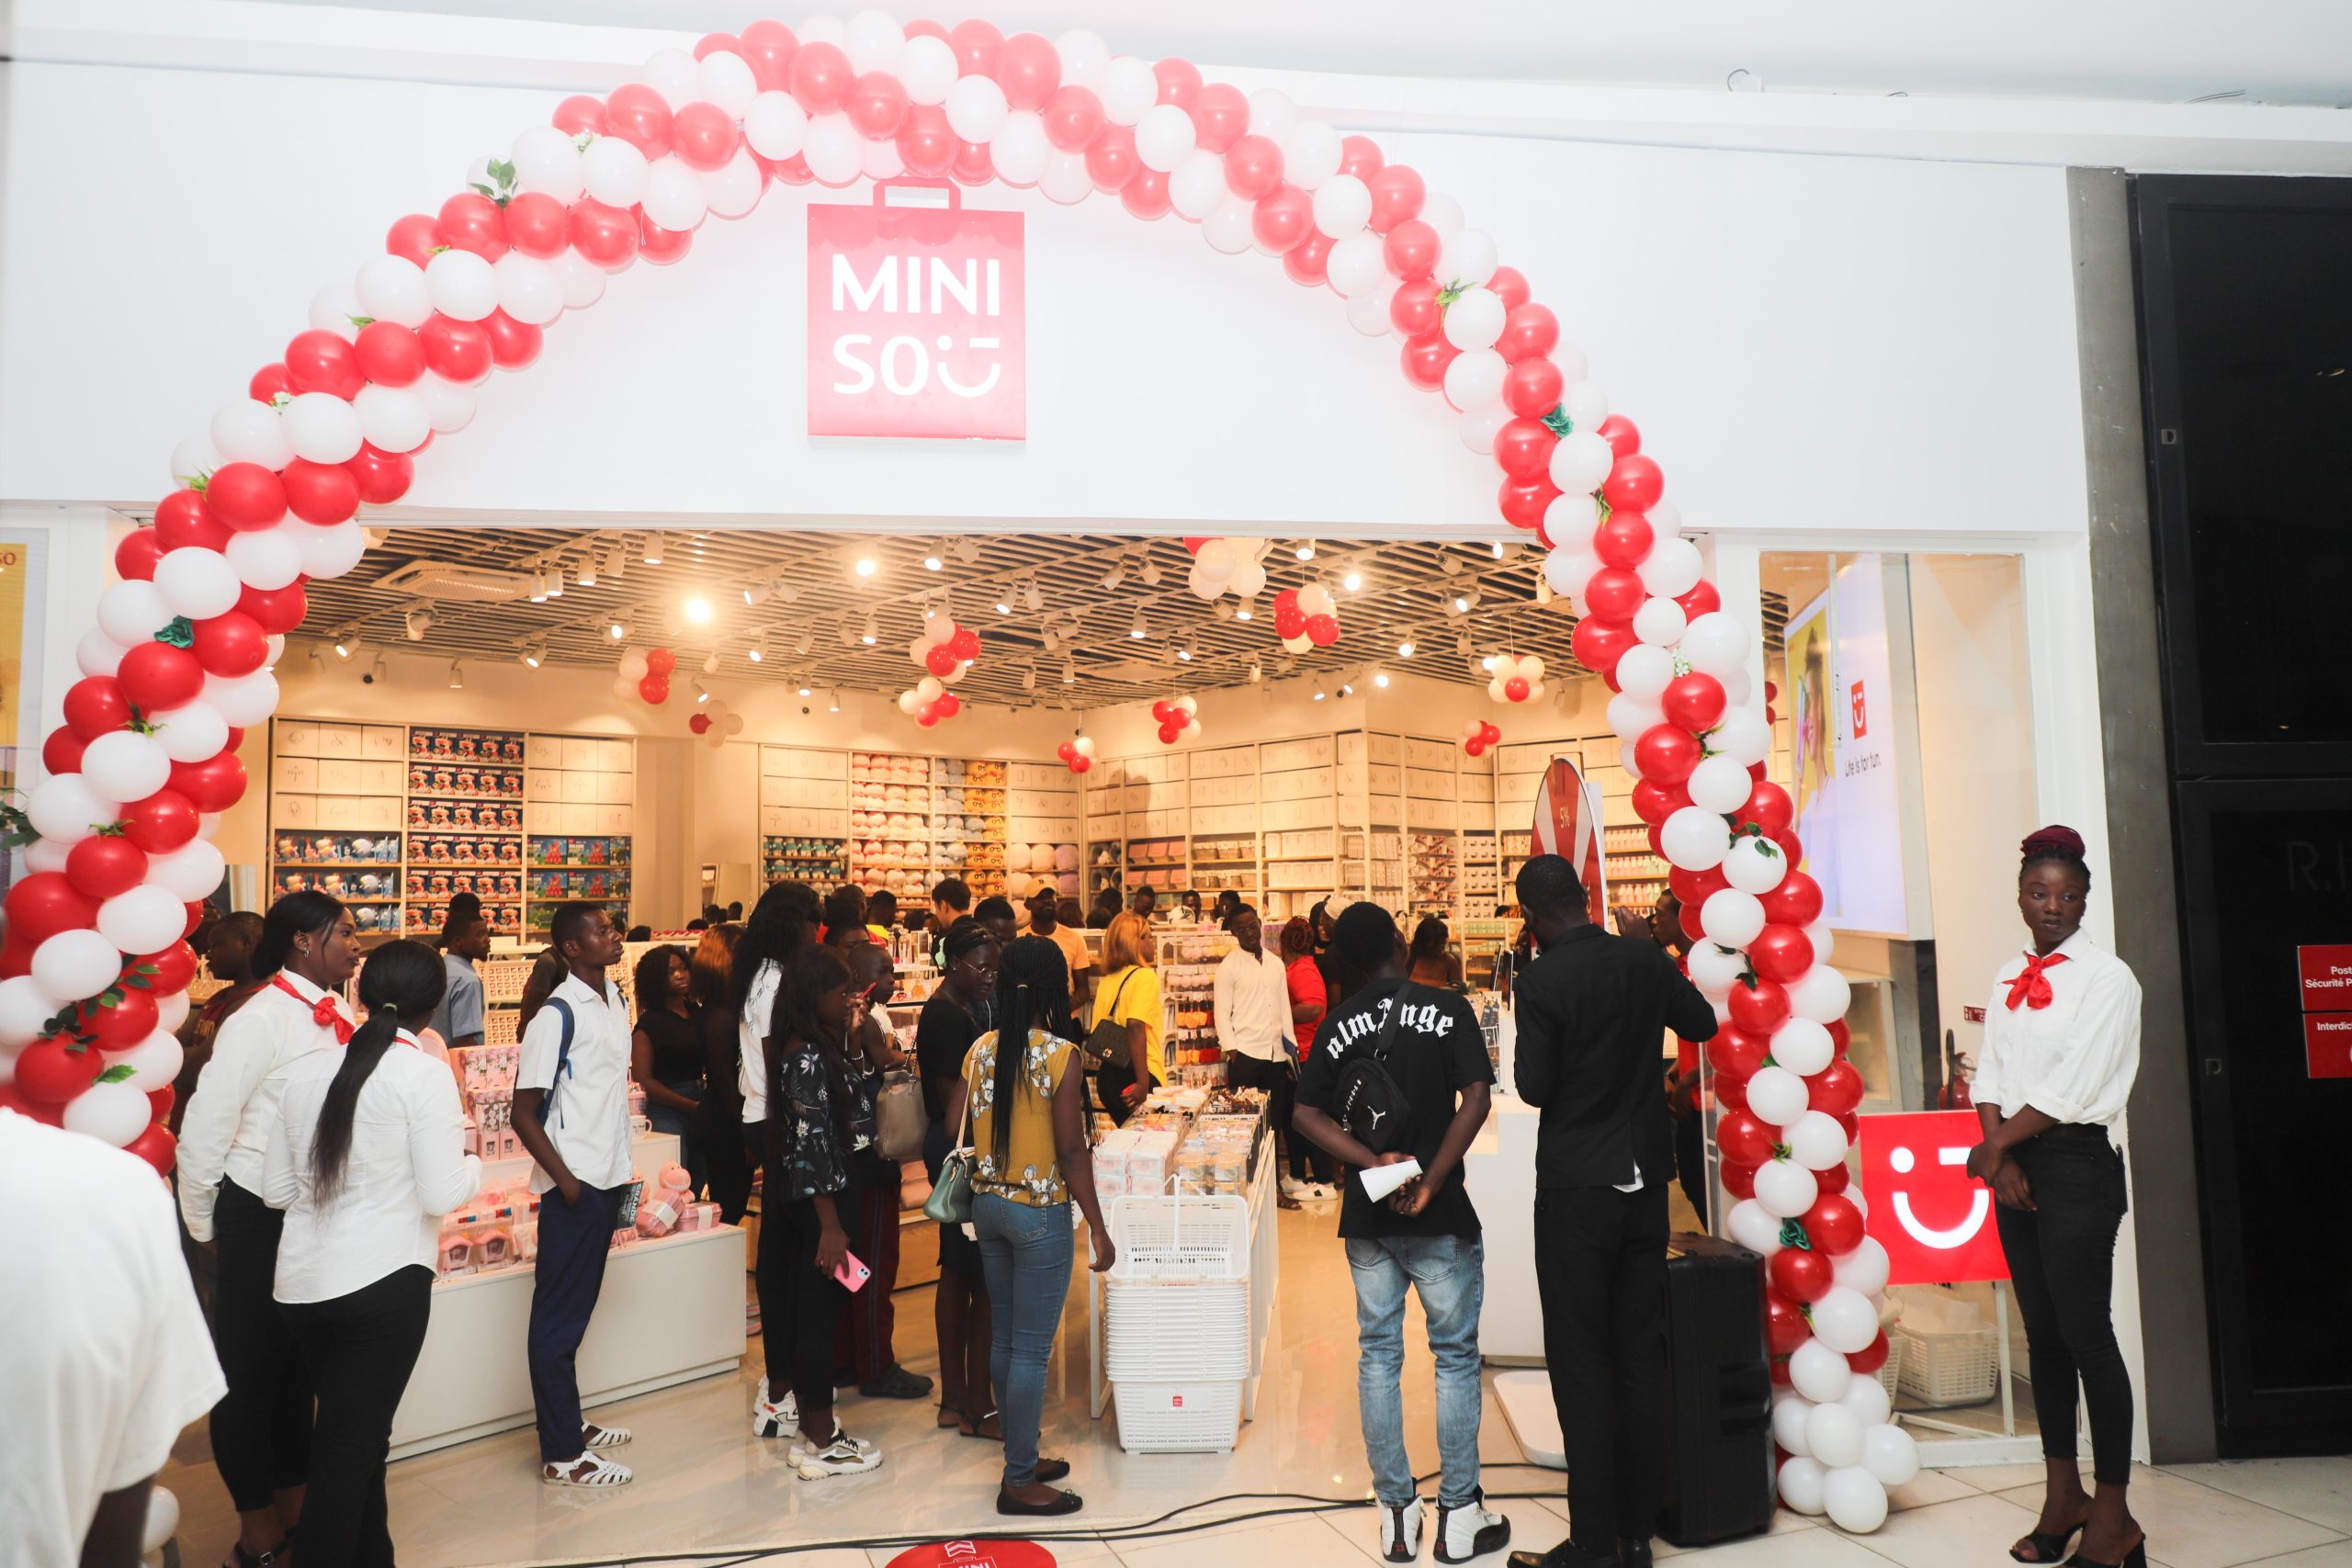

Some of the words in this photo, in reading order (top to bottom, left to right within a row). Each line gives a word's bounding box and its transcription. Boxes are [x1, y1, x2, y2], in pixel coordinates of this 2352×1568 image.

[832, 254, 1001, 316] MINI
[1844, 759, 1855, 778] Life
[2304, 978, 2345, 989] Sécurité
[2316, 1021, 2352, 1032] Interdic
